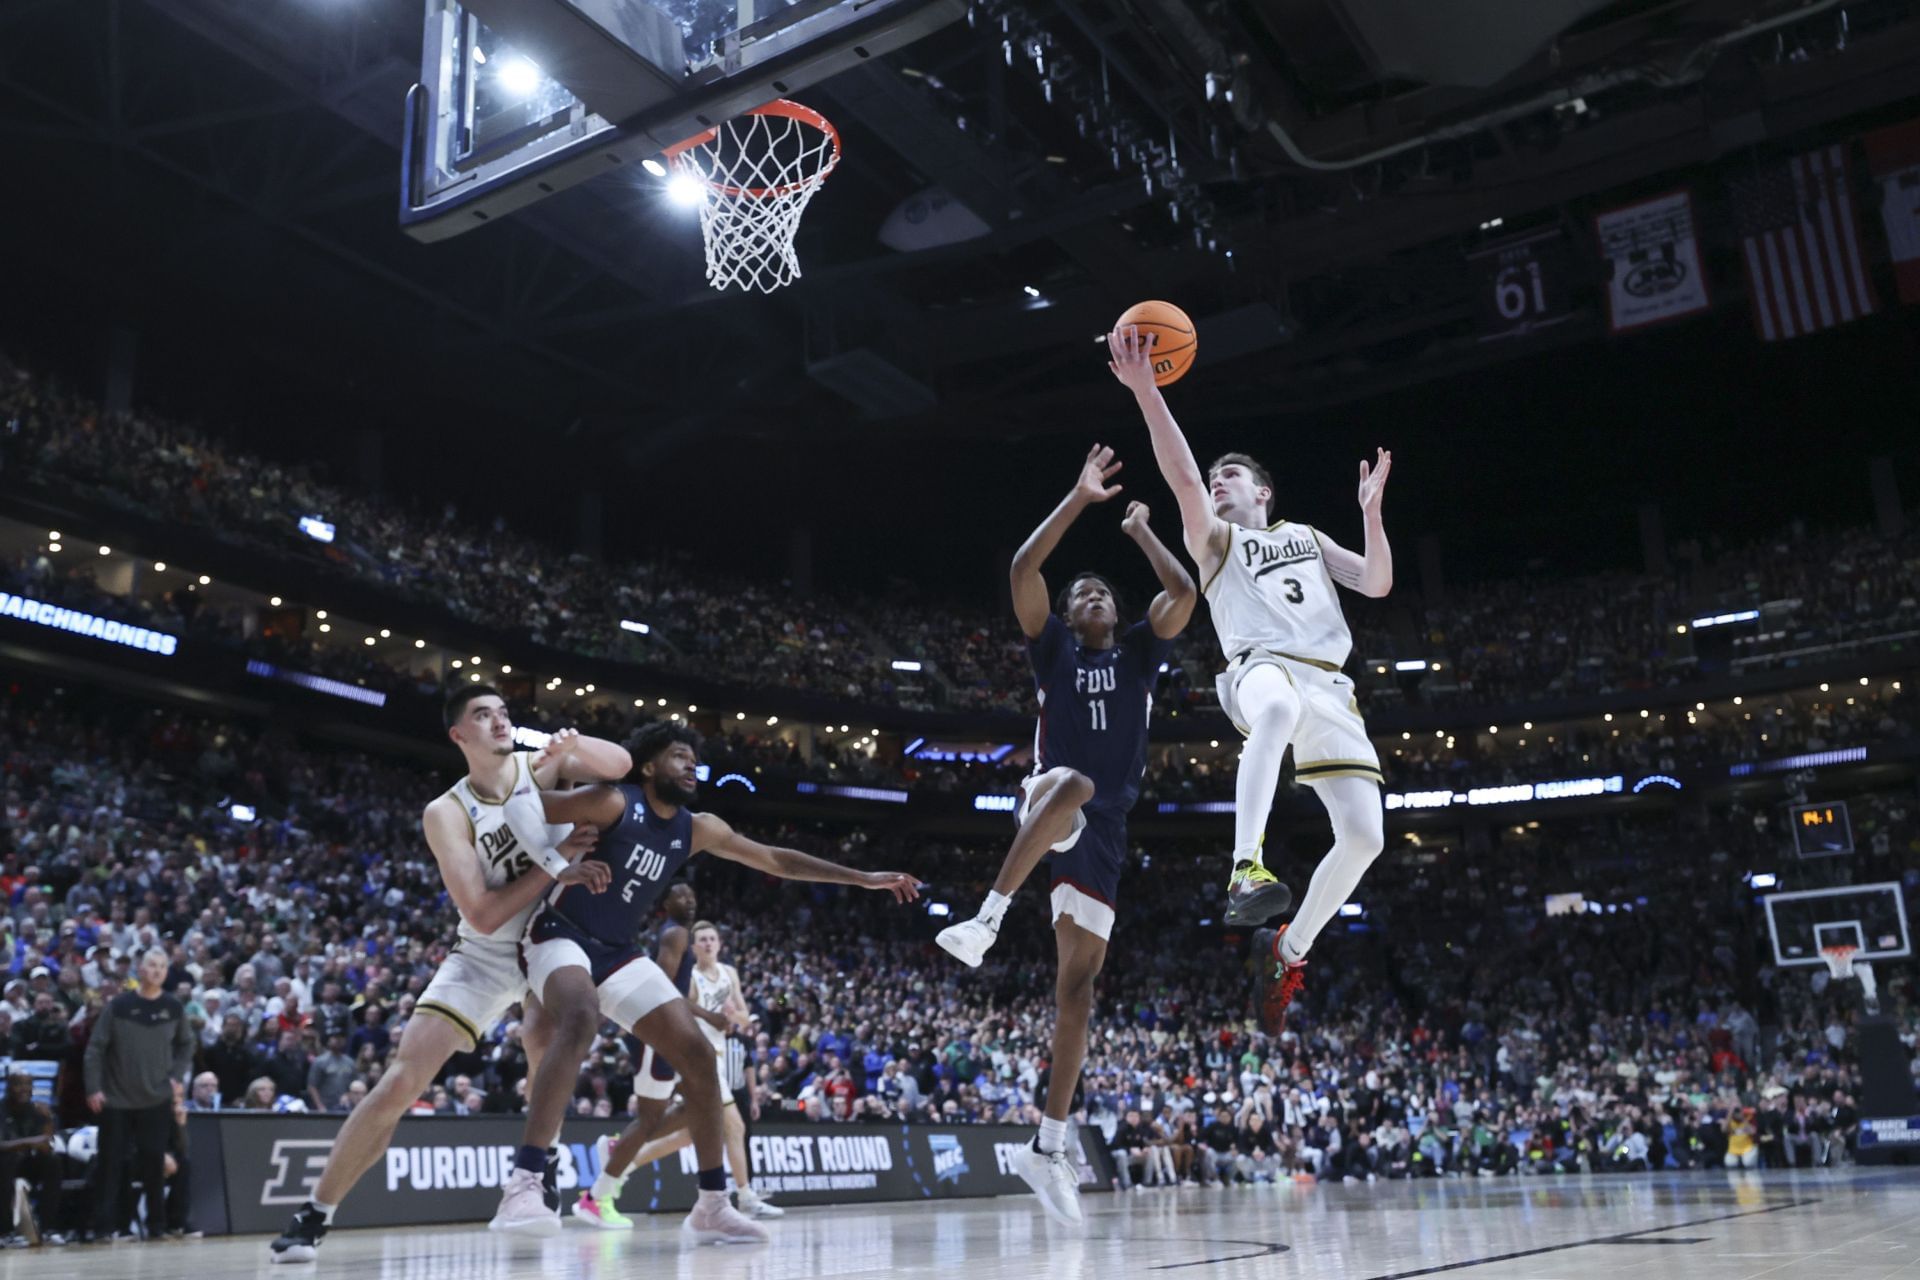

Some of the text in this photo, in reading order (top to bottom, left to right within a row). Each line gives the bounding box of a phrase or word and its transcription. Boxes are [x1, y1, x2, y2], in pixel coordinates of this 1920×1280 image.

[1495, 260, 1546, 320] 61
[1242, 537, 1318, 567] Purdue
[1284, 578, 1304, 604] 3
[1076, 666, 1116, 693] FDU
[1088, 699, 1107, 730] 11
[624, 843, 667, 881] FDU
[621, 878, 641, 903] 5
[386, 1145, 515, 1191] PURDUE
[749, 1136, 815, 1173] FIRST
[817, 1136, 892, 1172] ROUND
